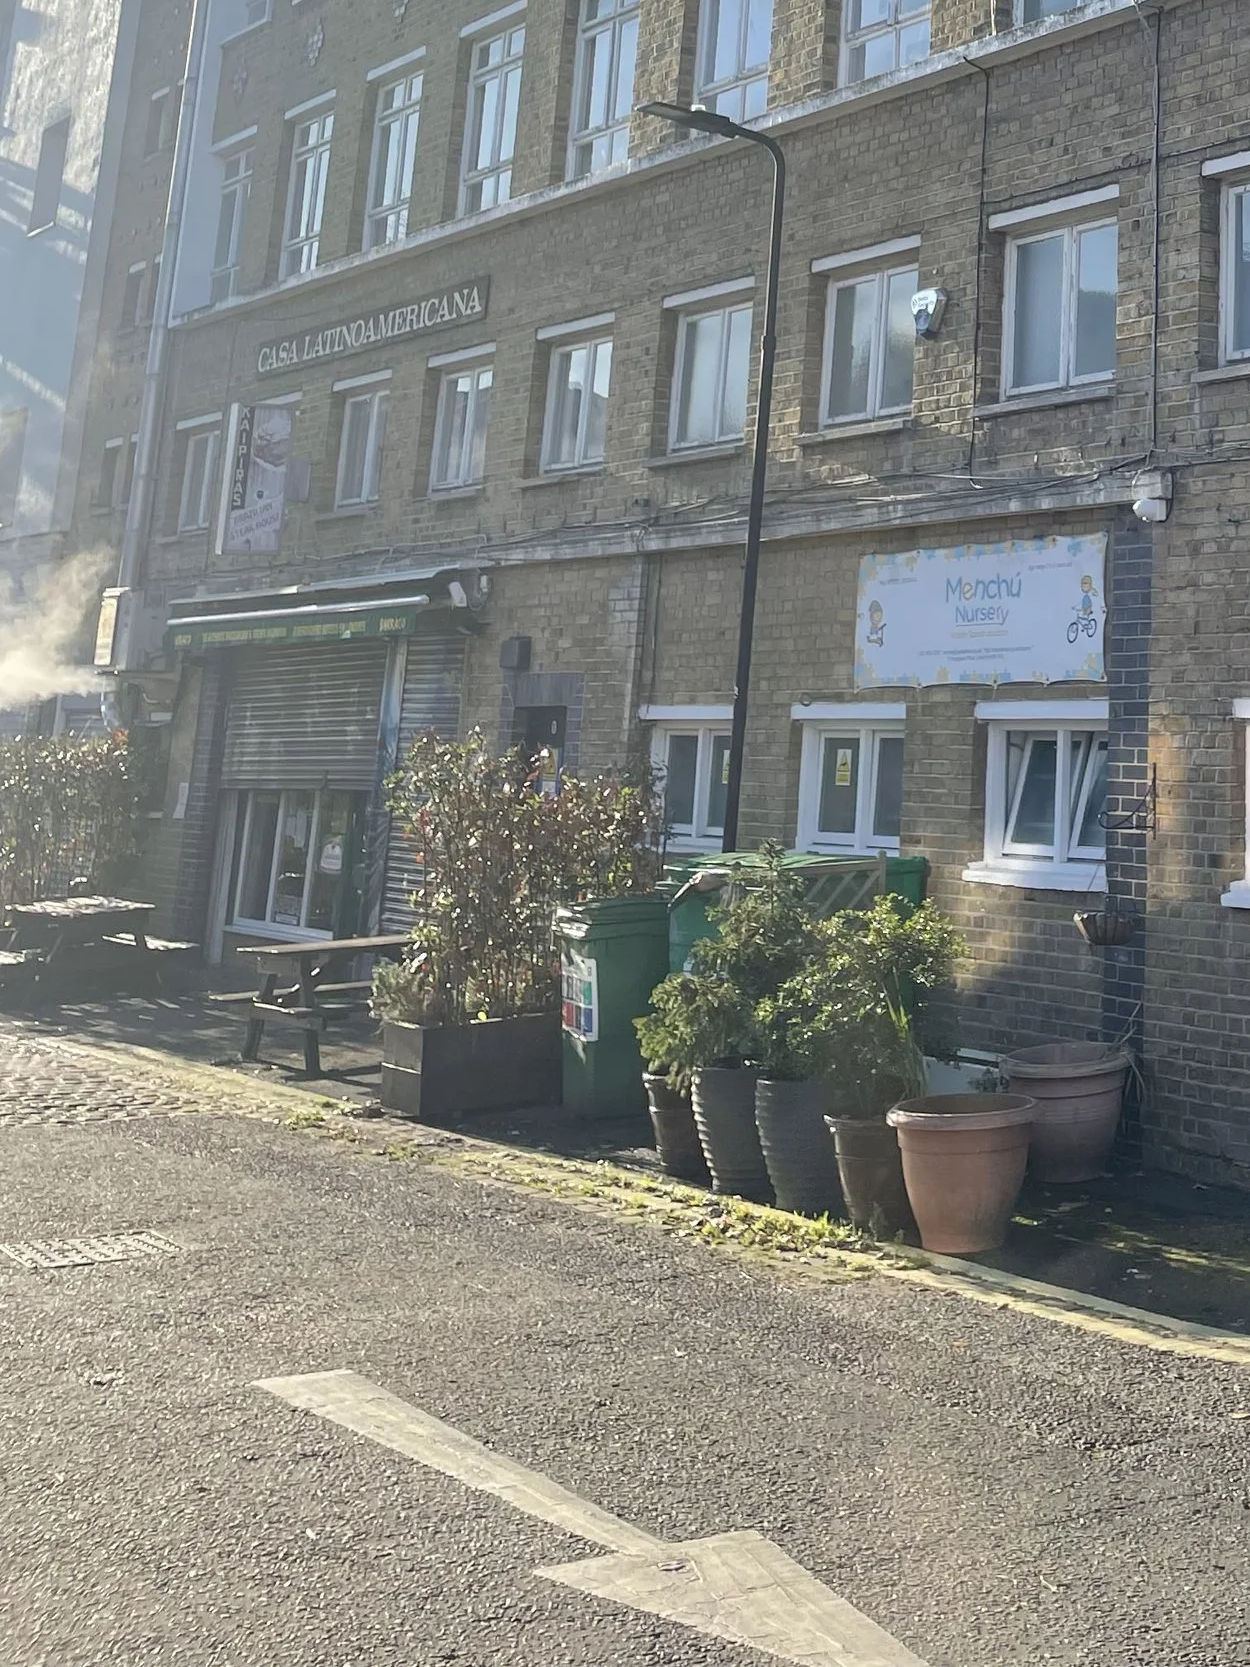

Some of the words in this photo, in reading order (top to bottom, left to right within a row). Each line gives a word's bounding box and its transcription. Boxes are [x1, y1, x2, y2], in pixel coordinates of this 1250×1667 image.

[257, 340, 299, 372] CASA
[302, 286, 482, 359] LATINOAMERICANA
[232, 407, 250, 506] KAIPIRAS
[946, 572, 1022, 603] Menchú
[955, 605, 1009, 626] Nursery
